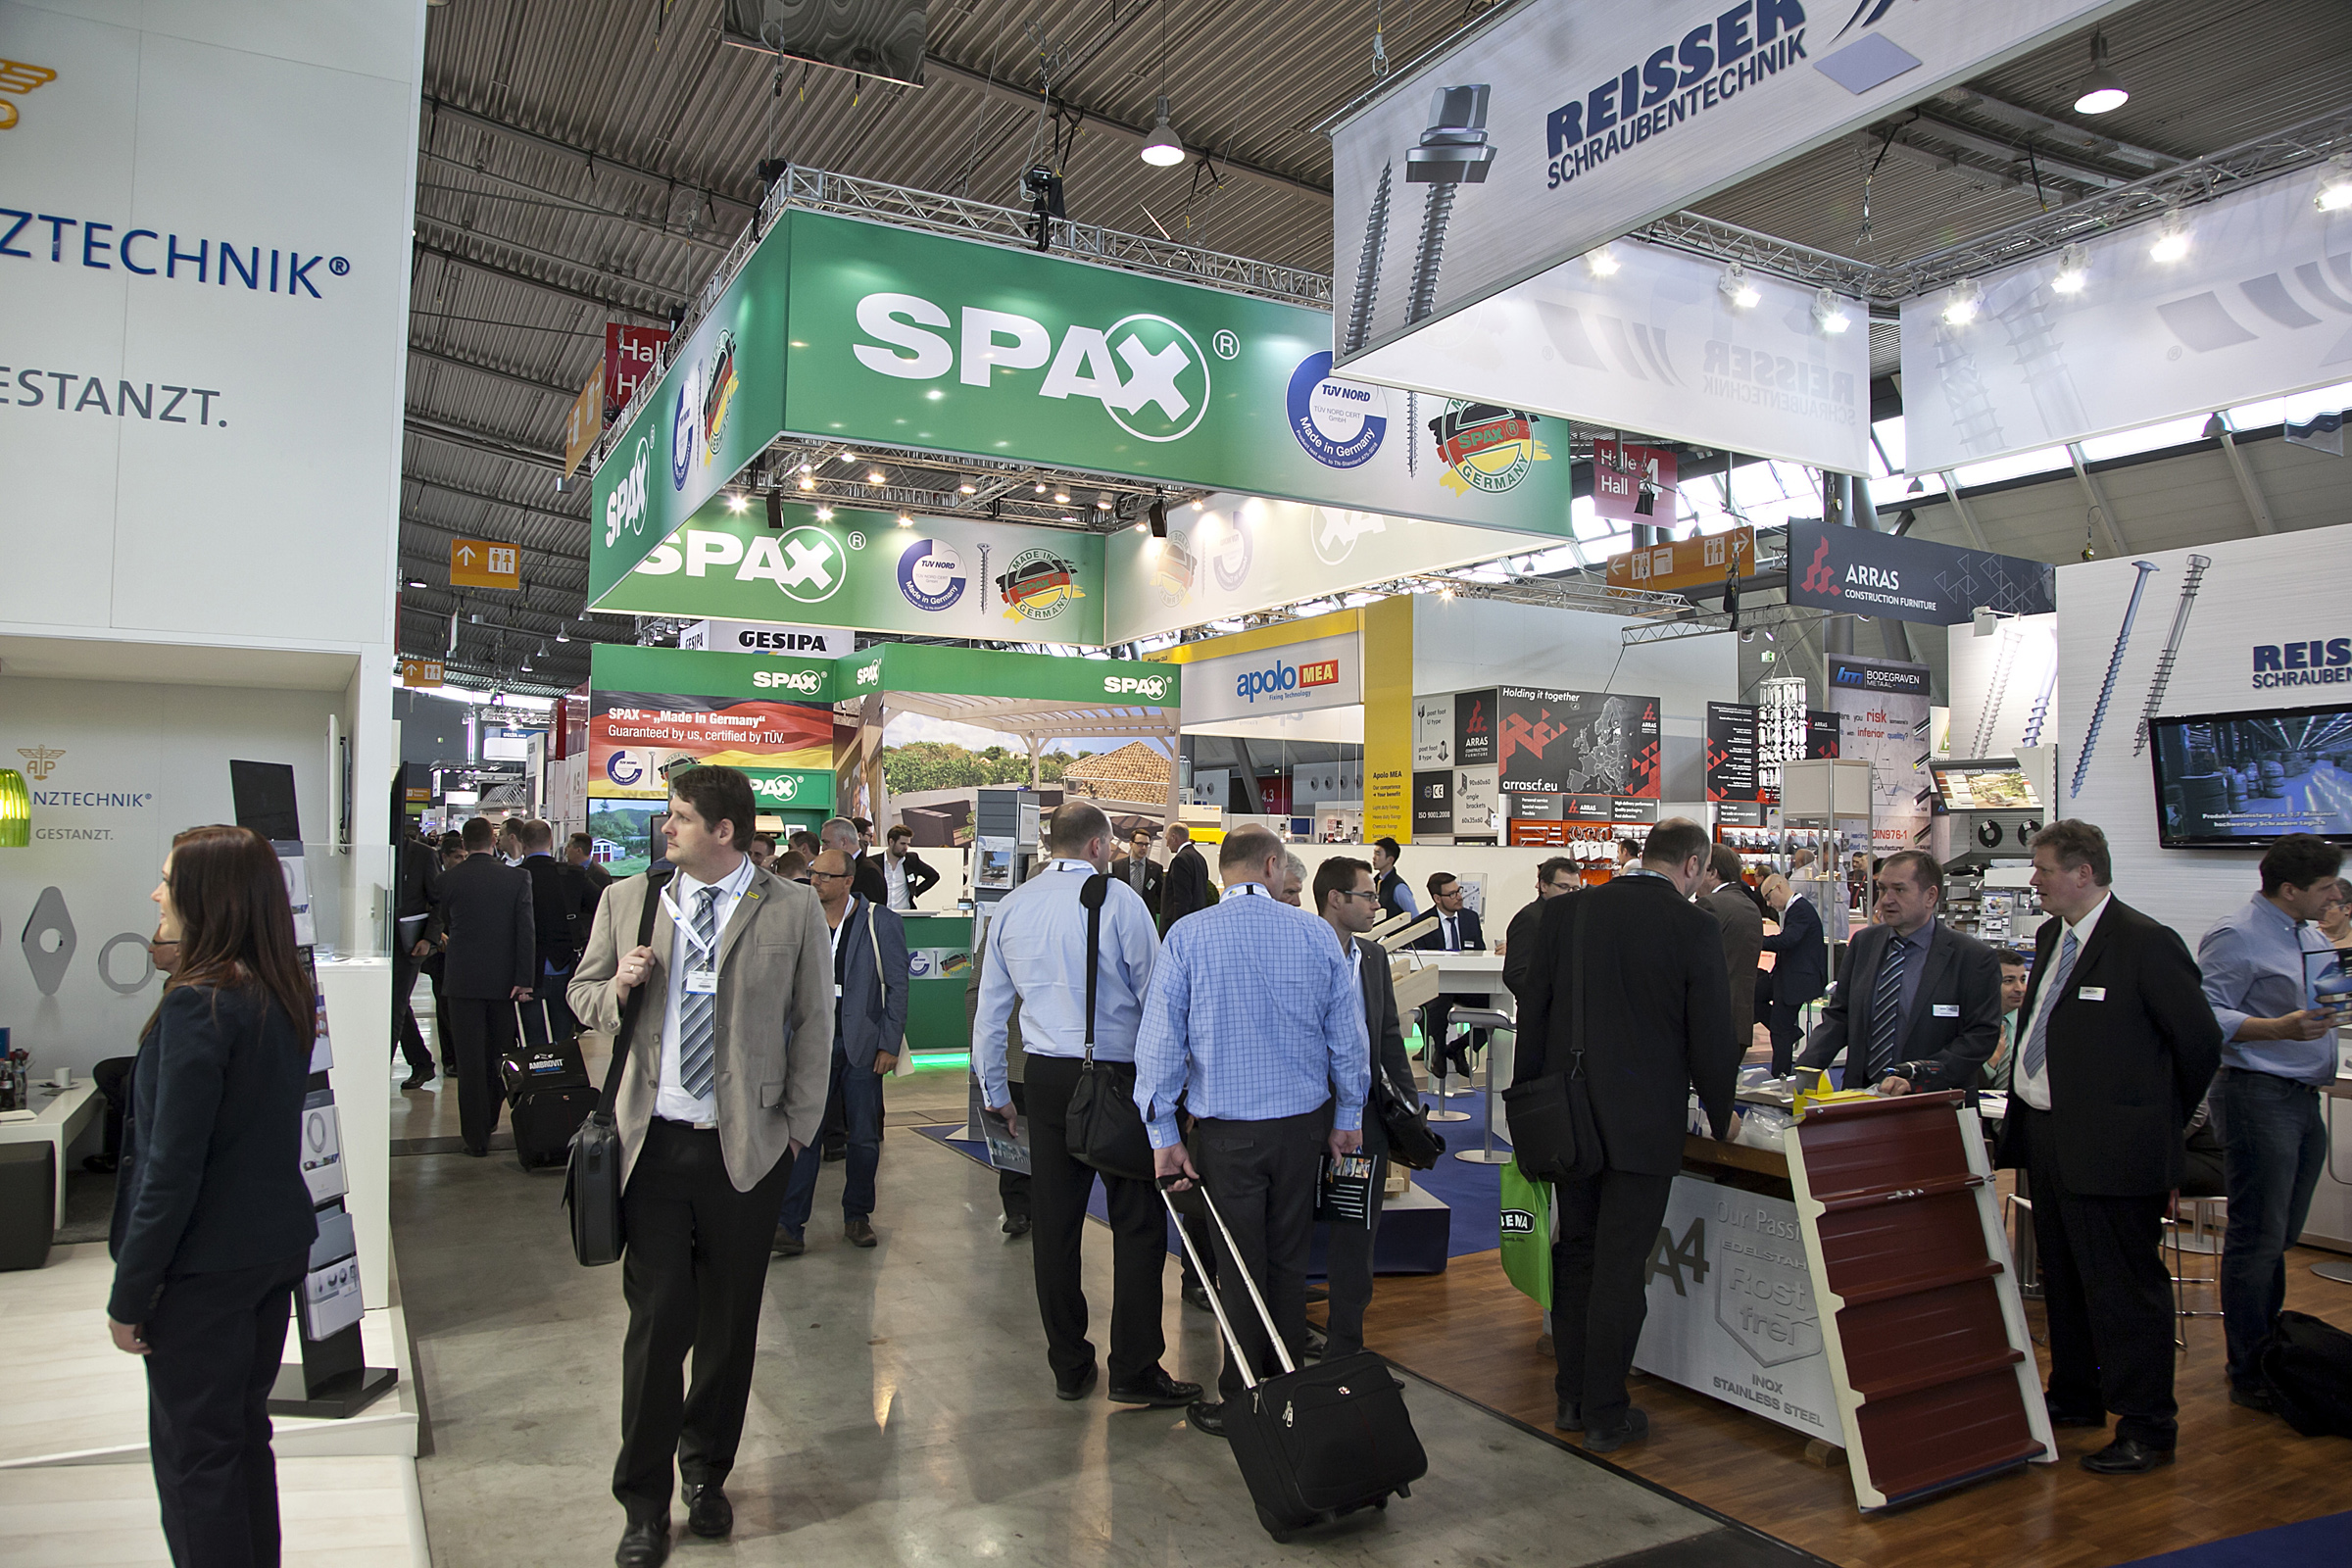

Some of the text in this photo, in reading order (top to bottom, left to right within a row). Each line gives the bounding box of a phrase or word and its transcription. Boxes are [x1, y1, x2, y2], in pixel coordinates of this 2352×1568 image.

[1546, 0, 1806, 160] REISSER
[1546, 27, 1807, 190] SCHRAUBENTECHNIK
[1342, 387, 1371, 403] NORD
[1326, 408, 1345, 416] NORD
[1345, 410, 1361, 419] CERT
[1328, 415, 1347, 423] GmbH
[1299, 416, 1376, 458] Made in Germany
[1457, 423, 1506, 449] SPAX
[1600, 448, 1637, 470] Hlle
[1462, 453, 1529, 490] GERMANY
[1600, 474, 1629, 496] Hall
[935, 561, 956, 569] NORD
[1012, 551, 1054, 570] MADE IN
[1844, 564, 1900, 591] ARRAS
[906, 580, 921, 600] Made
[930, 584, 958, 605] Germany
[1844, 588, 1937, 612] CONSTRUCTION FURNITURE
[1019, 593, 1068, 618] GERMANY
[2253, 637, 2352, 672] REIS
[1237, 660, 1334, 704] apolo MEA
[1866, 669, 1920, 685] BODEGRAVEN
[1866, 679, 1892, 688] METAAL
[1284, 690, 1311, 699] Technology
[1502, 688, 1581, 703] Holding it together
[608, 707, 640, 720] SPAX
[695, 710, 707, 724] in
[1866, 708, 1887, 723] risk
[608, 724, 785, 745] Guaranteed by us, certified by TÜV.
[1465, 736, 1489, 747] ARRAS
[1857, 726, 1885, 739] inferior
[1372, 771, 1389, 780] Apolo
[1502, 778, 1558, 792] arrascf.eu
[30, 791, 153, 808] NZTECHNIK®
[1261, 788, 1274, 803] 4.3
[35, 828, 115, 841] GESTANZT.
[529, 1058, 564, 1070] AMBROVIT
[1716, 1200, 1802, 1243] Our Passi
[1644, 1216, 1710, 1298] A4
[1729, 1266, 1807, 1312] Rost
[1739, 1305, 1796, 1347] frei
[1751, 1373, 1785, 1396] INOX
[1712, 1376, 1826, 1429] STAINLESS STEEL
